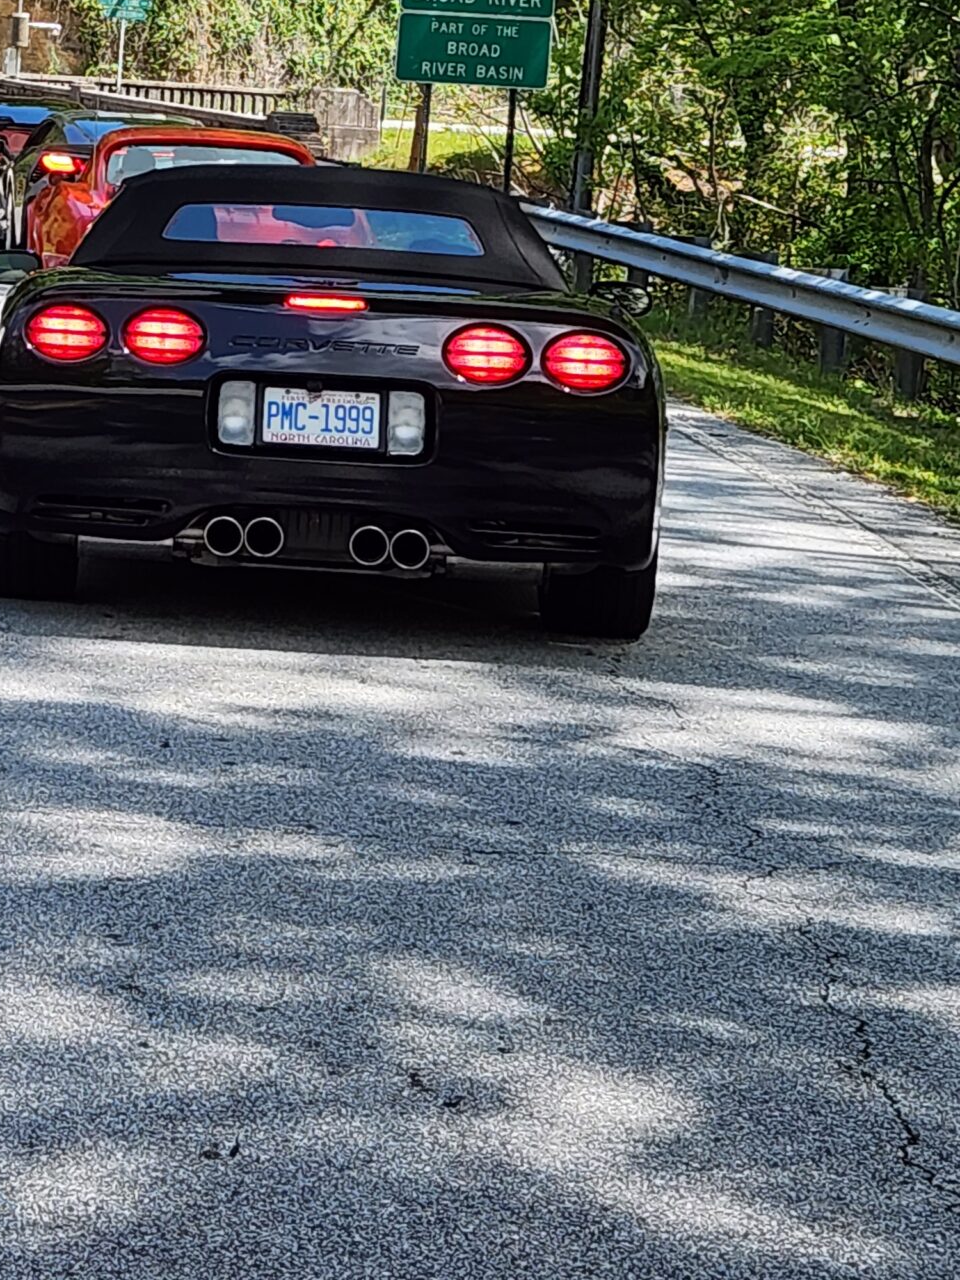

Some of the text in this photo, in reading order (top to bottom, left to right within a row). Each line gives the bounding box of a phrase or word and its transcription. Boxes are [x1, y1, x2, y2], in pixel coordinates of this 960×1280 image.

[431, 21, 519, 38] PART OF THE
[447, 41, 501, 58] BROAD
[421, 61, 524, 81] RIVER BASIN
[228, 334, 421, 356] CORVETTE
[266, 401, 374, 435] PMC-1999
[270, 432, 371, 447] NORTH CAROLINA
